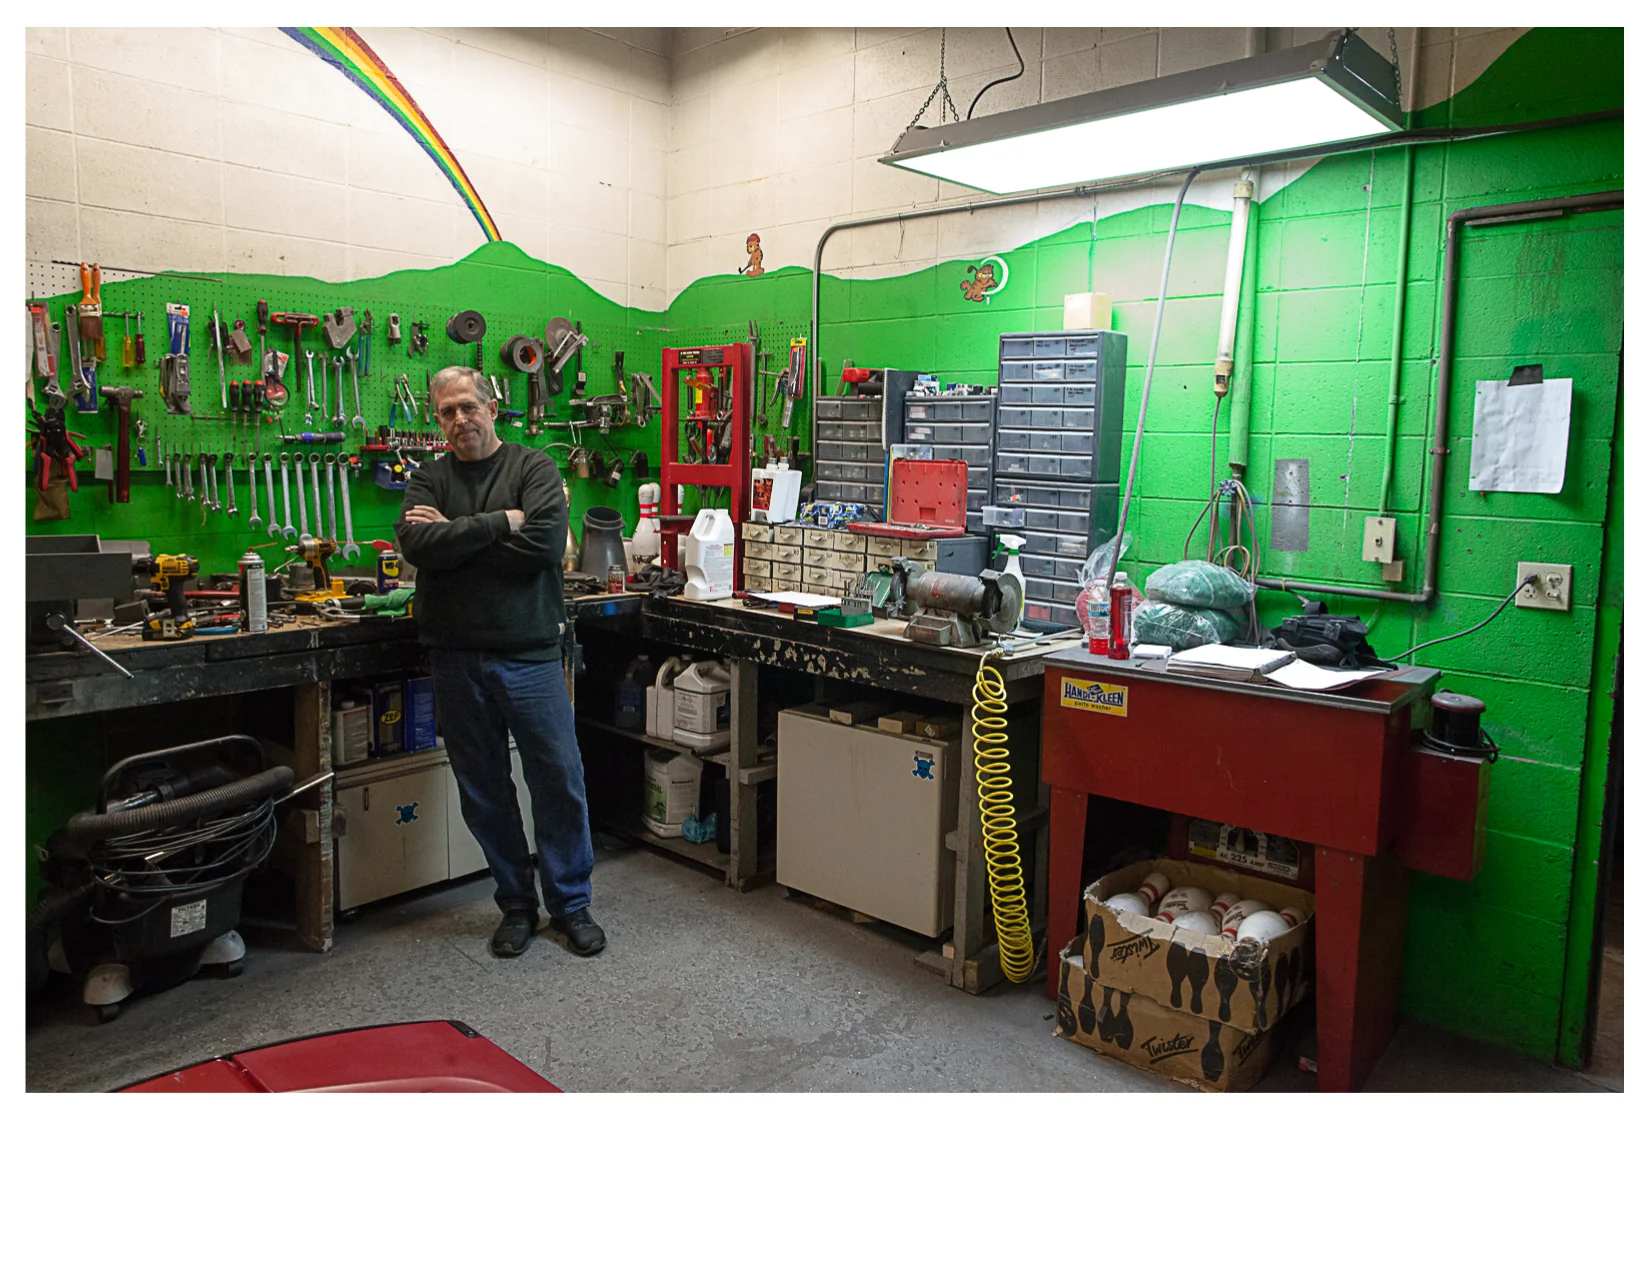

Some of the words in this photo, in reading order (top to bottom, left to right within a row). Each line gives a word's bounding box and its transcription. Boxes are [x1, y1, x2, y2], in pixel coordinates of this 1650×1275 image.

[1064, 682, 1124, 706] HANDI-KLEEN
[1091, 703, 1112, 711] washer
[1230, 853, 1247, 864] 225
[1250, 860, 1265, 868] AMP
[1110, 934, 1160, 964] Twister
[1140, 1032, 1195, 1058] Twister
